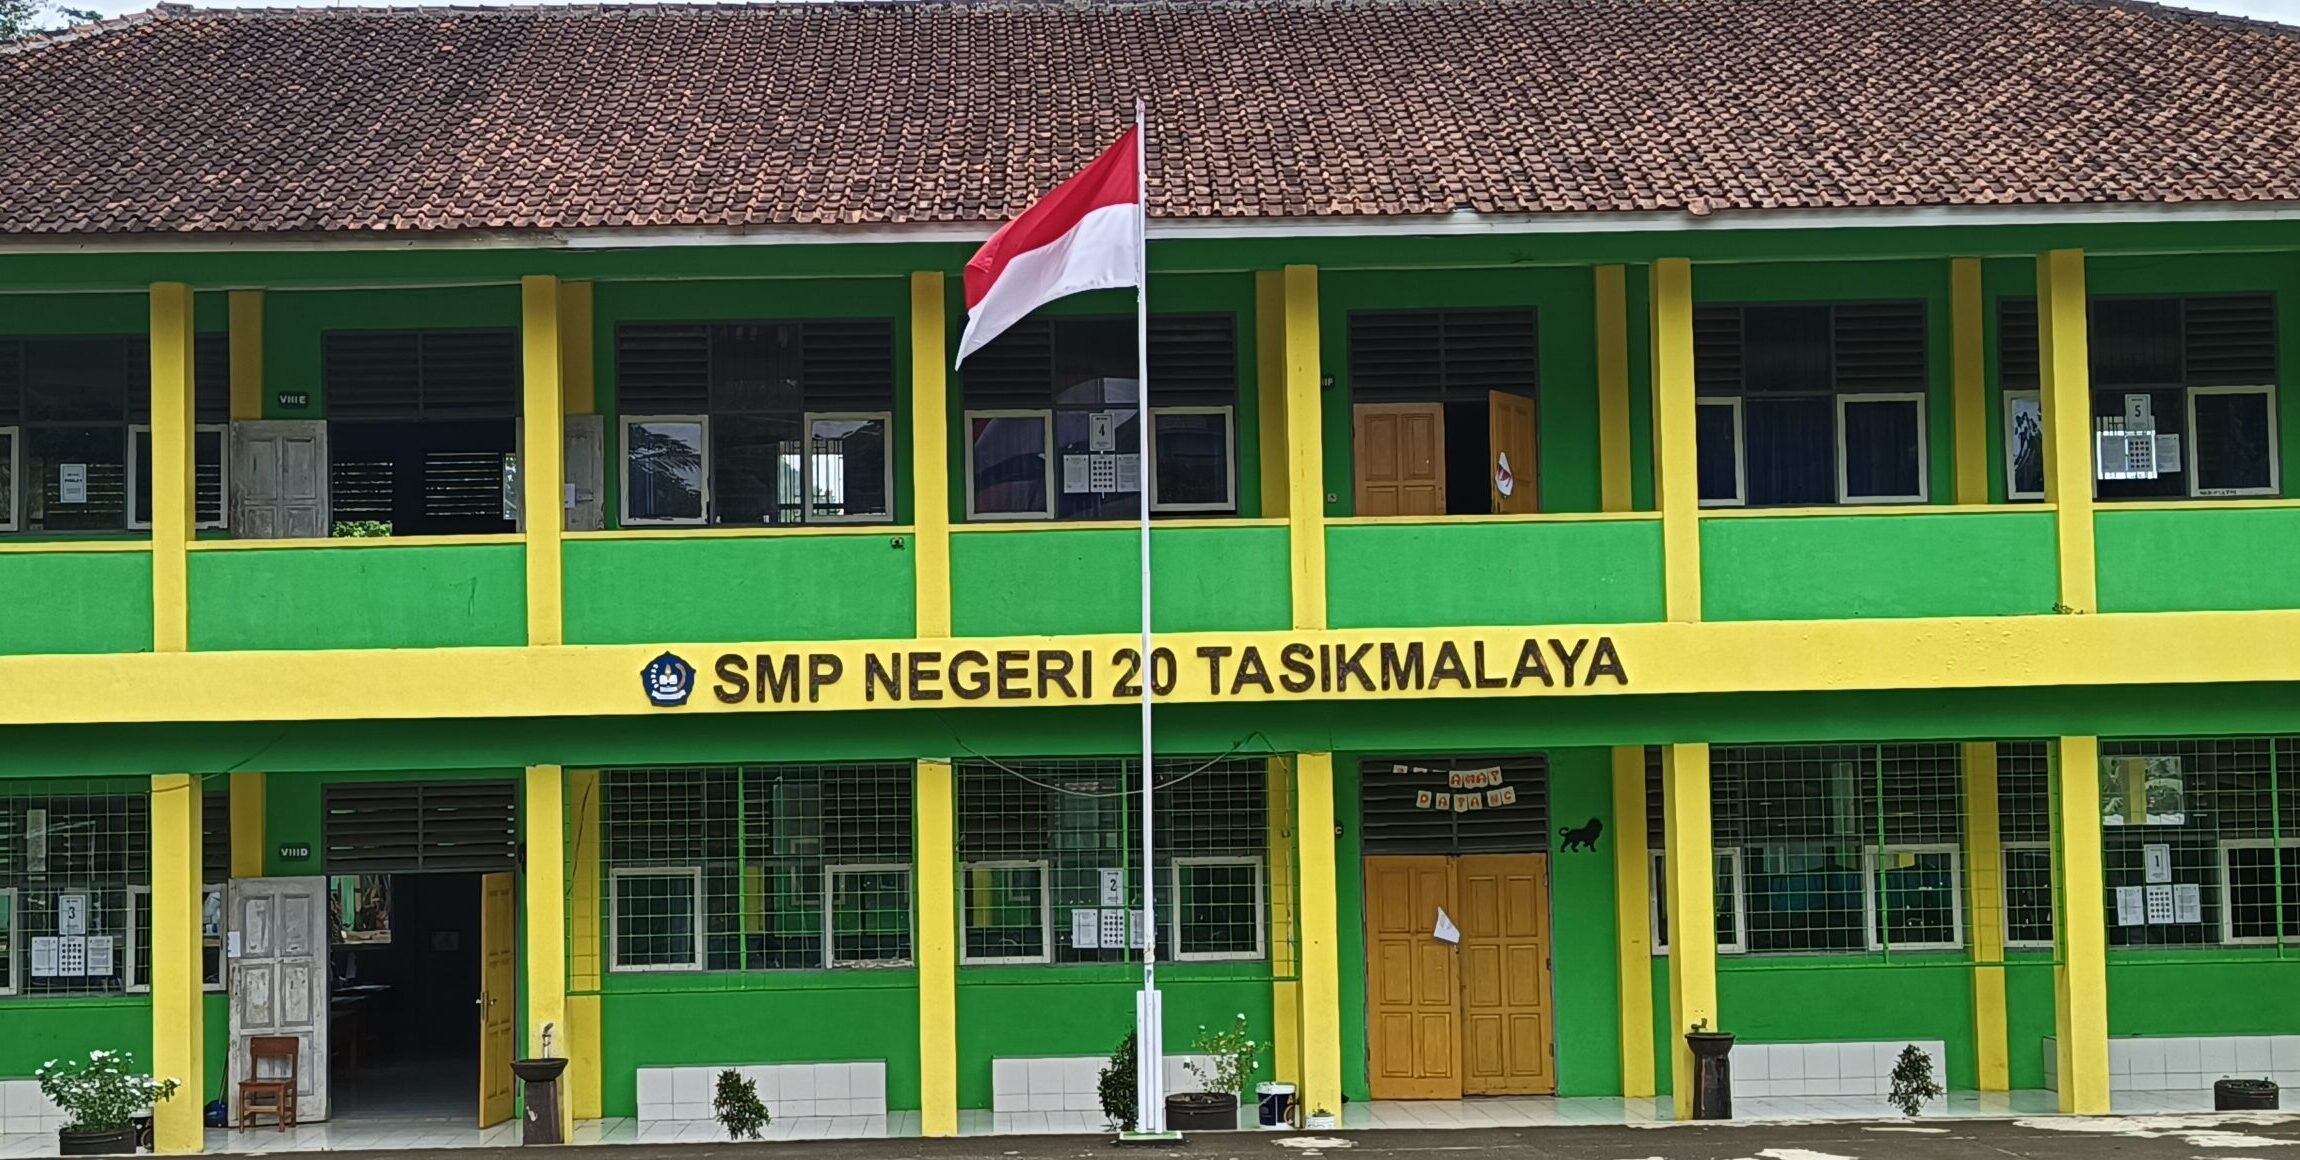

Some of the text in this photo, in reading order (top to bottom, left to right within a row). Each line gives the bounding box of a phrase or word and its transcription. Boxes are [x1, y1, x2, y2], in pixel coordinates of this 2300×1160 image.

[2134, 404, 2142, 418] 5
[1098, 423, 1106, 437] 4
[713, 636, 1629, 704] SMP NEGERI 20 TASIKMALAYA
[1110, 878, 1117, 892] 2
[69, 906, 76, 920] 3
